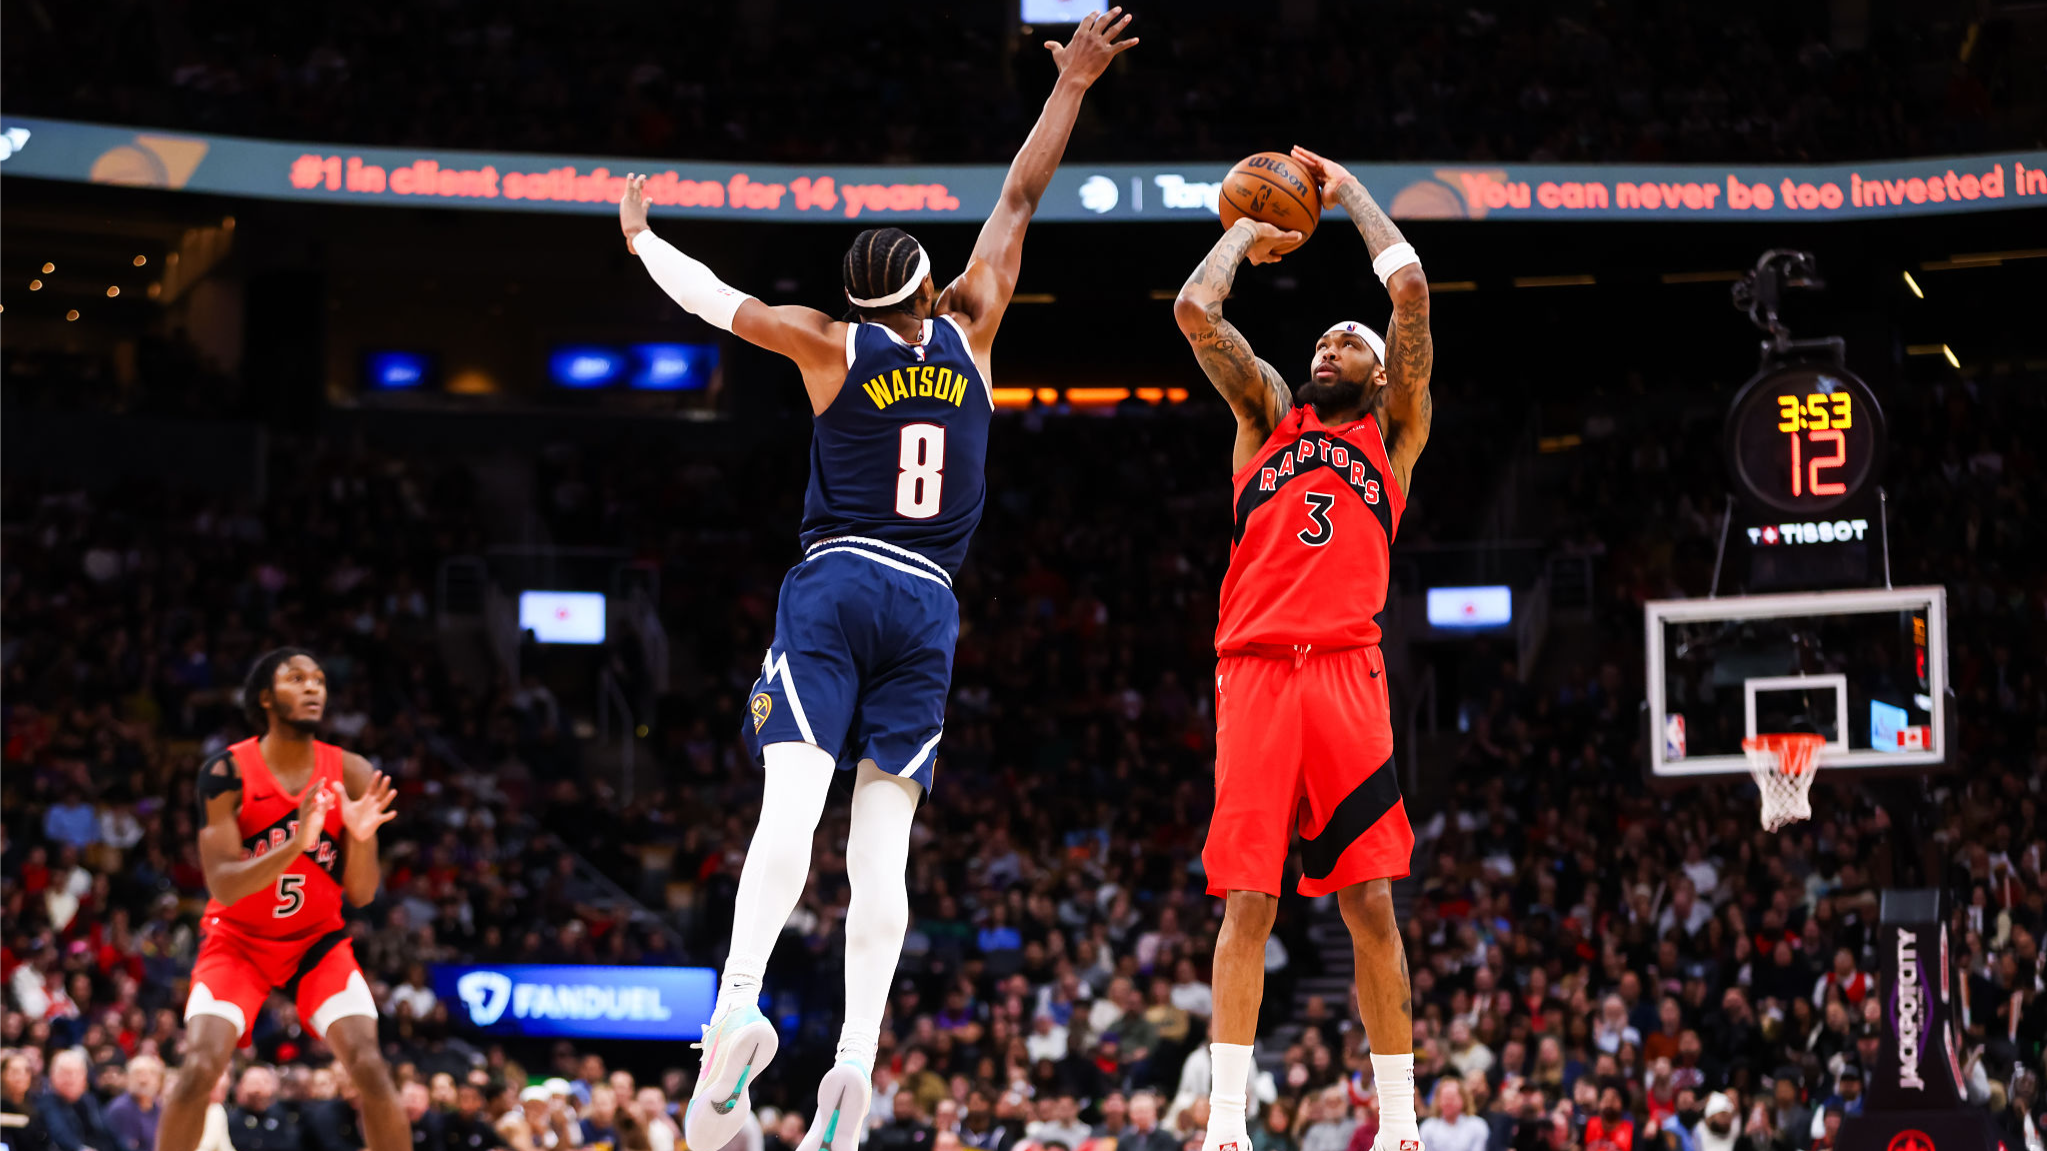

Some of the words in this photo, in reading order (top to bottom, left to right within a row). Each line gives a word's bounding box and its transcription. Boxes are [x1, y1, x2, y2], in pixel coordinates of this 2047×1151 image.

[290, 155, 341, 191] #1
[346, 157, 386, 193] in
[389, 160, 499, 198] client
[502, 166, 725, 209] satisfation
[728, 173, 786, 210] for
[791, 176, 838, 211] 14
[842, 183, 960, 218] years.
[1248, 157, 1308, 198] Wilson
[1460, 173, 1531, 209] You
[1537, 182, 1609, 209] can
[1616, 182, 1721, 210] never
[1727, 174, 1775, 210] be
[1780, 178, 1844, 210] too
[1851, 164, 2005, 208] invested
[862, 366, 968, 410] WATSON
[1777, 391, 1852, 433] 3:53
[894, 421, 947, 520] 8
[1259, 437, 1379, 504] RAPTORS
[1791, 428, 1847, 497] 12
[1297, 491, 1335, 547] 3
[1779, 519, 1868, 545] TISSOT
[272, 873, 306, 919] 5
[513, 983, 672, 1021] FANDUEL
[1897, 927, 1925, 1092] JACKPOTCITY
